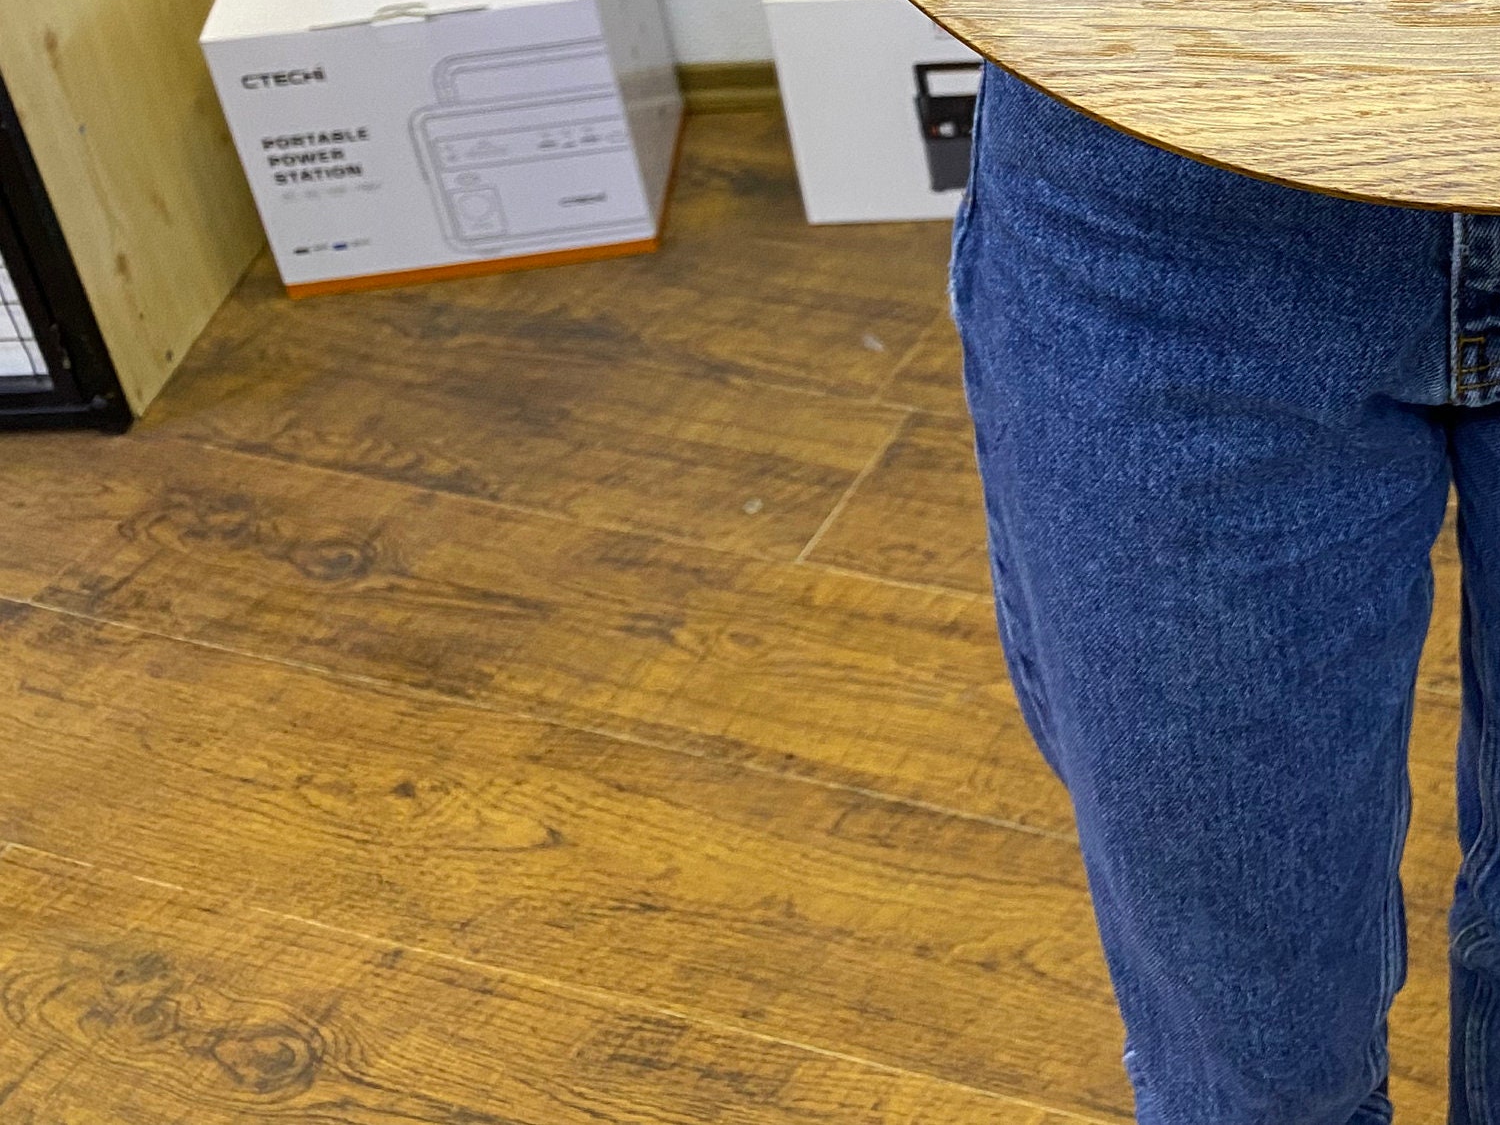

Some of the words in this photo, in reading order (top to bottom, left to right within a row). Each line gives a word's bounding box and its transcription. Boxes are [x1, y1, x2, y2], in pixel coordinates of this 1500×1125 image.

[262, 127, 369, 150] PORTABLE
[267, 148, 345, 167] POWER
[274, 164, 363, 186] STATION
